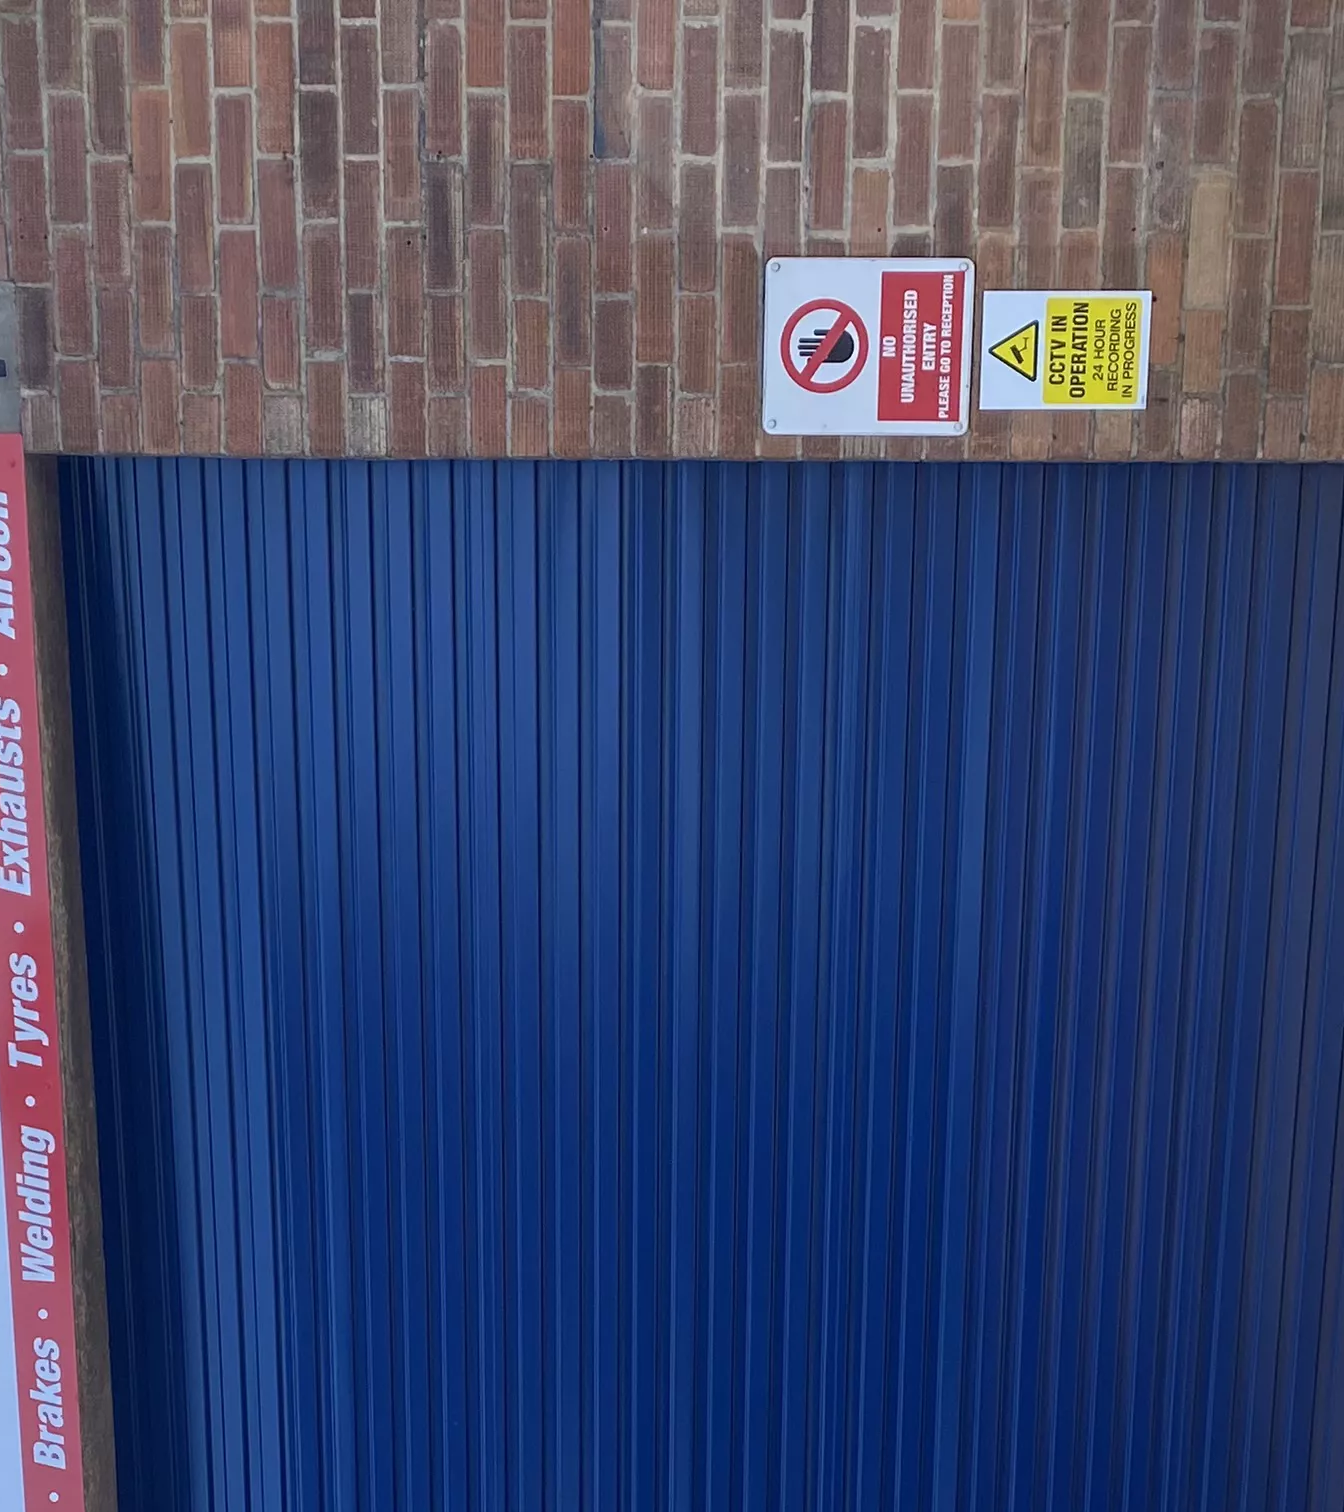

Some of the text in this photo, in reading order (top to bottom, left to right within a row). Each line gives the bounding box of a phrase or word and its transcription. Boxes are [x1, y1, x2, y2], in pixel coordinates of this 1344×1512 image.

[882, 336, 896, 358] NO
[901, 290, 918, 404] UNAUTHORISED
[922, 323, 937, 371] ENTRY
[938, 274, 954, 418] PLEASE GO TO RECEPTION
[1049, 315, 1067, 385] CCTV IN
[1069, 302, 1089, 398] OPERATION
[1093, 319, 1105, 380] 24 HOUR
[1107, 309, 1121, 391] RECORDING
[1122, 302, 1137, 398] IN PROGRESS
[8, 953, 49, 1067] Tyres
[16, 1125, 55, 1282] Welding
[30, 1338, 66, 1469] Brakes
